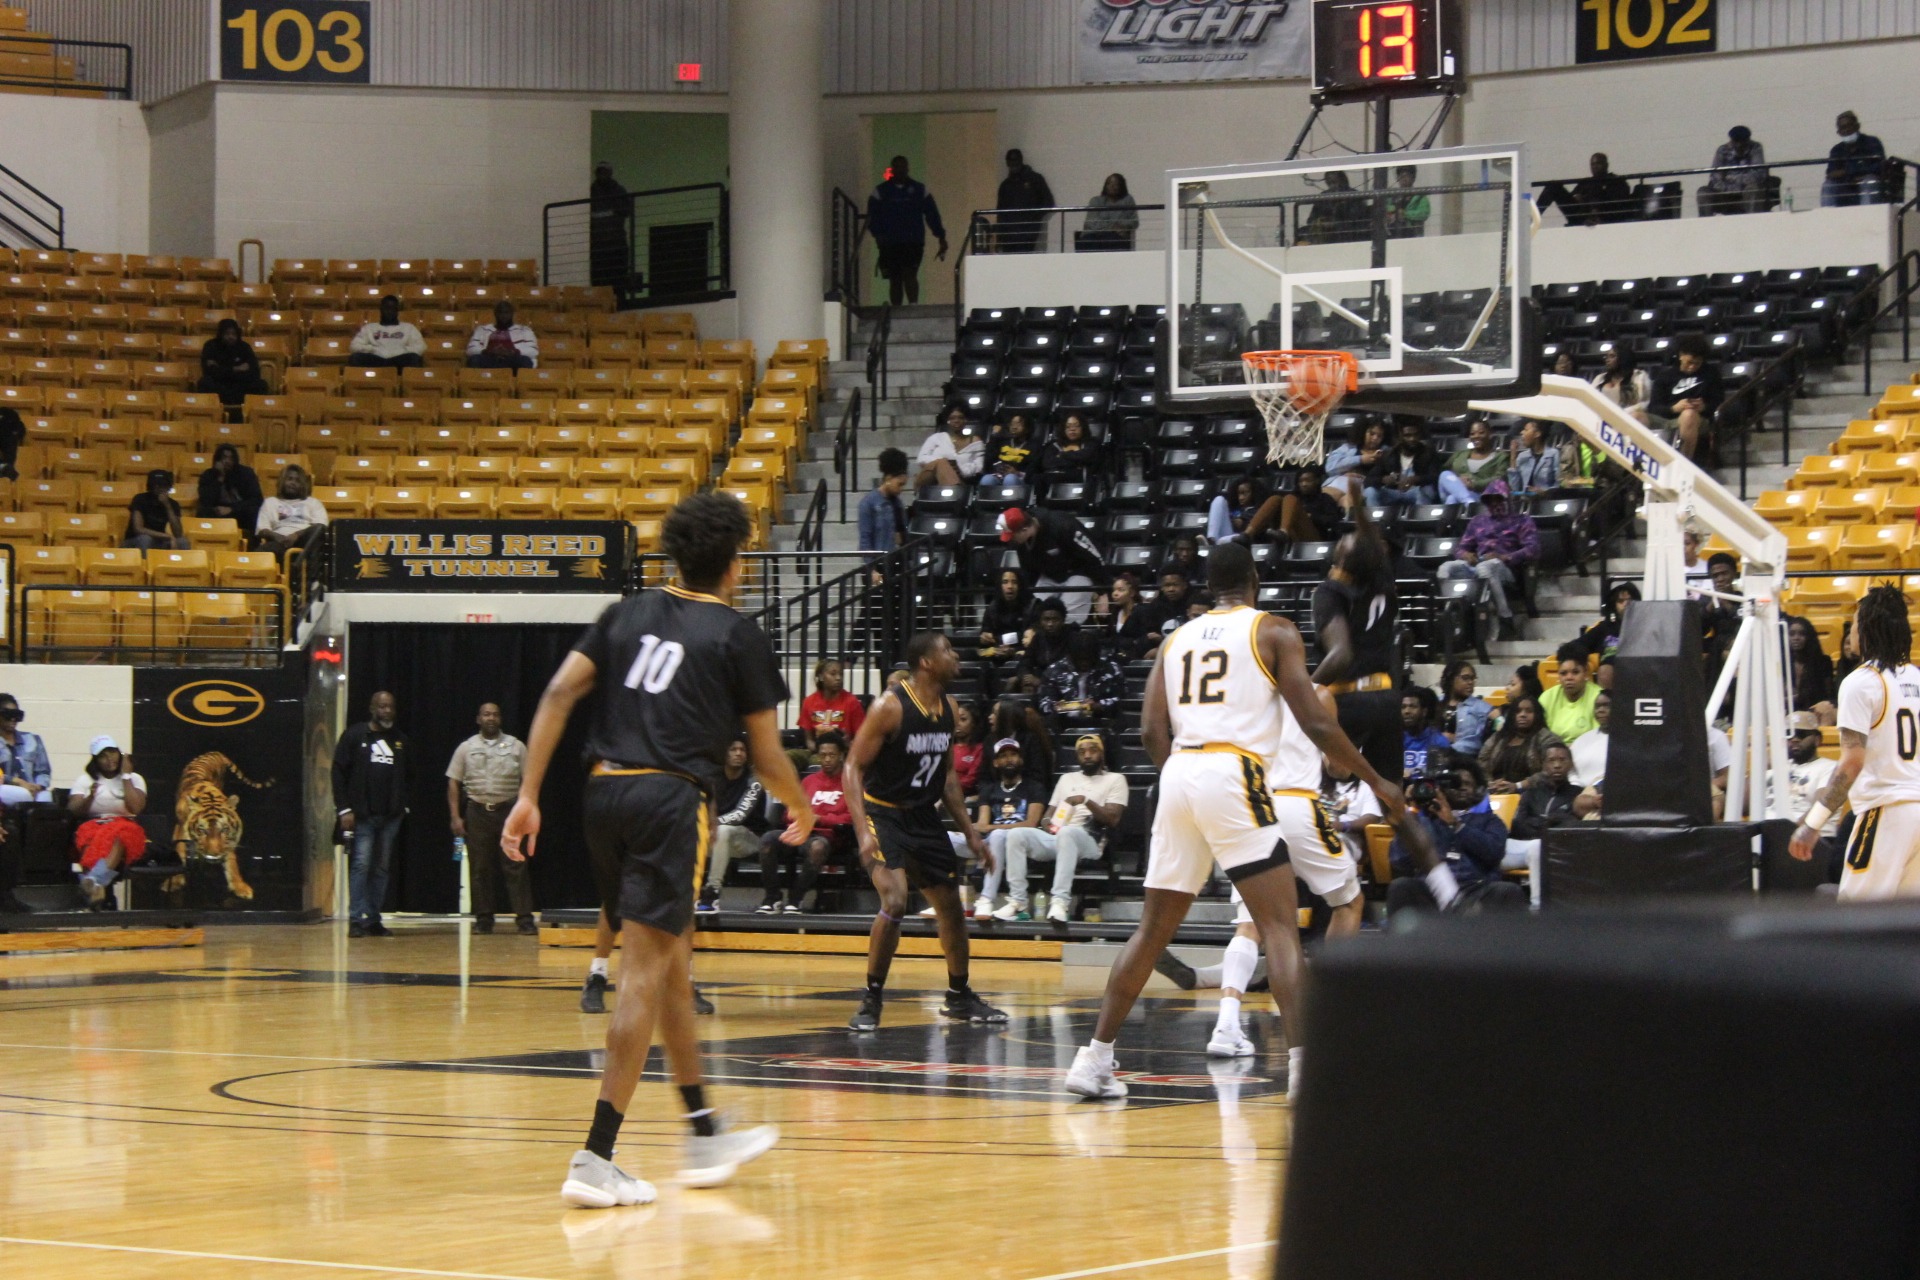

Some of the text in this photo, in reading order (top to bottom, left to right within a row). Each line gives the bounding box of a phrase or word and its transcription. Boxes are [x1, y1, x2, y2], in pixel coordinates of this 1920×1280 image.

[227, 8, 365, 73] 103
[1102, 4, 1286, 43] LIGHT
[1358, 4, 1415, 78] 13
[1582, 0, 1711, 50] 102
[354, 534, 606, 557] WILLIS REED
[403, 559, 559, 577] TUNNEL
[624, 634, 685, 694] 10
[1178, 649, 1229, 705] 12
[911, 754, 941, 787] 21
